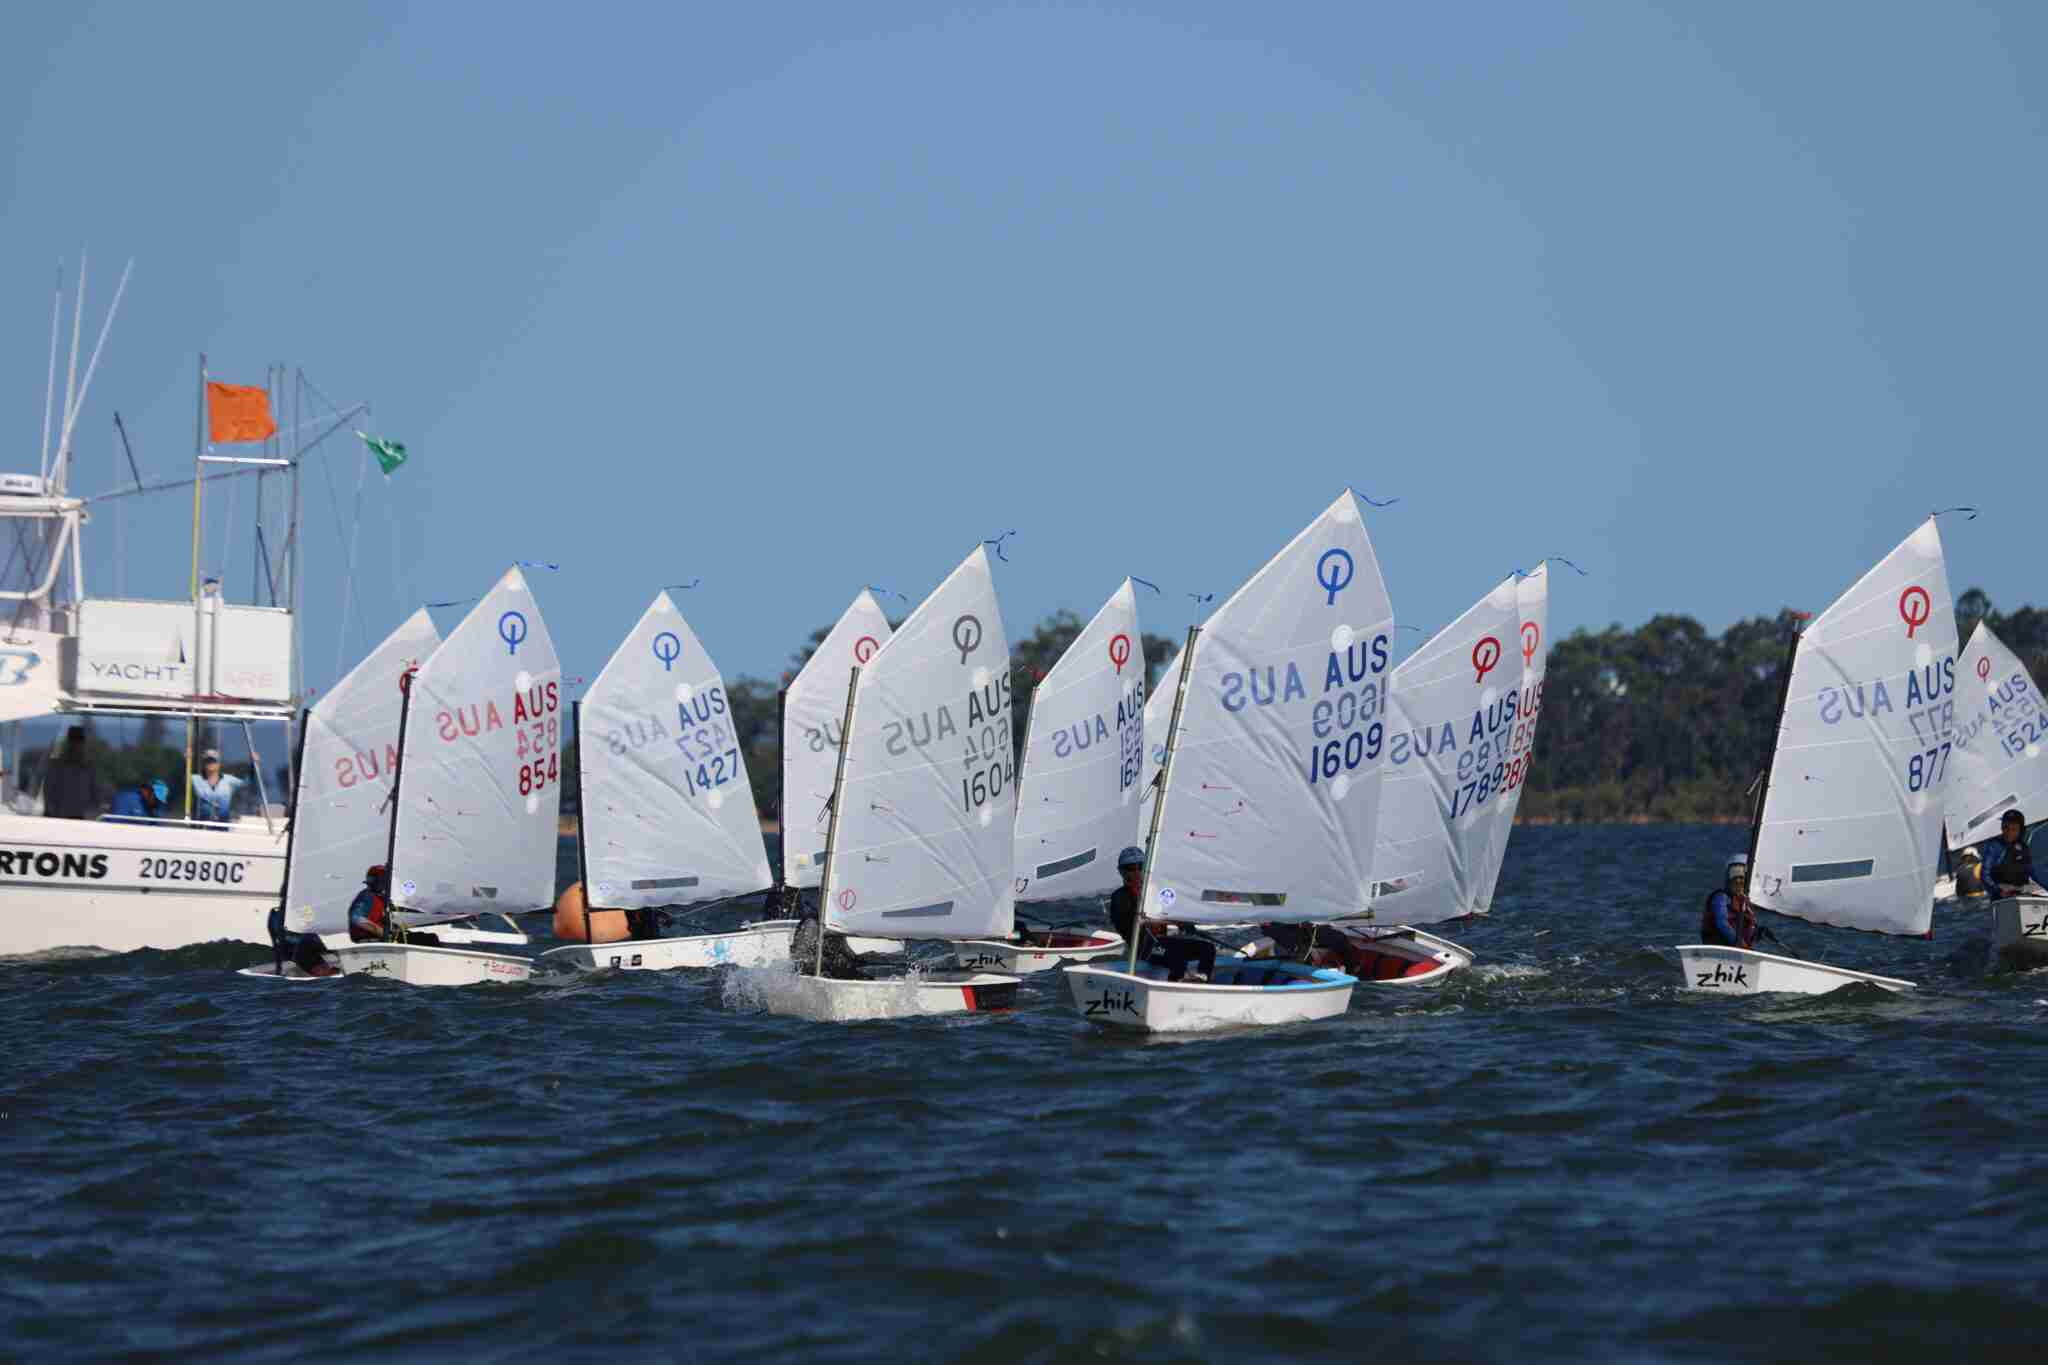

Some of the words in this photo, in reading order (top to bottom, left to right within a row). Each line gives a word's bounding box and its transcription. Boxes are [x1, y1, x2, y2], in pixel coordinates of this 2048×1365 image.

[90, 662, 179, 681] YACHT
[1323, 634, 1388, 692] AUS
[1907, 656, 1955, 709] AUS
[514, 681, 558, 724] AUS
[678, 688, 725, 731] AUS
[968, 671, 1010, 728] AUS
[1116, 681, 1143, 731] AUS
[1469, 690, 1517, 744] AUS
[1516, 681, 1545, 720] US
[1989, 674, 2027, 714] AUS
[1311, 722, 1384, 784] 1609
[2001, 712, 2048, 758] 1524
[518, 752, 558, 796] 854
[684, 747, 738, 797] 1427
[962, 754, 1013, 812] 1604
[1908, 742, 1952, 792] 877
[1451, 762, 1505, 819] 1789
[0, 850, 109, 880] RTONS
[139, 857, 245, 884] 20298QC
[965, 951, 1007, 969] zhik
[1696, 962, 1749, 988] zhik
[1084, 989, 1139, 1016] zhik
